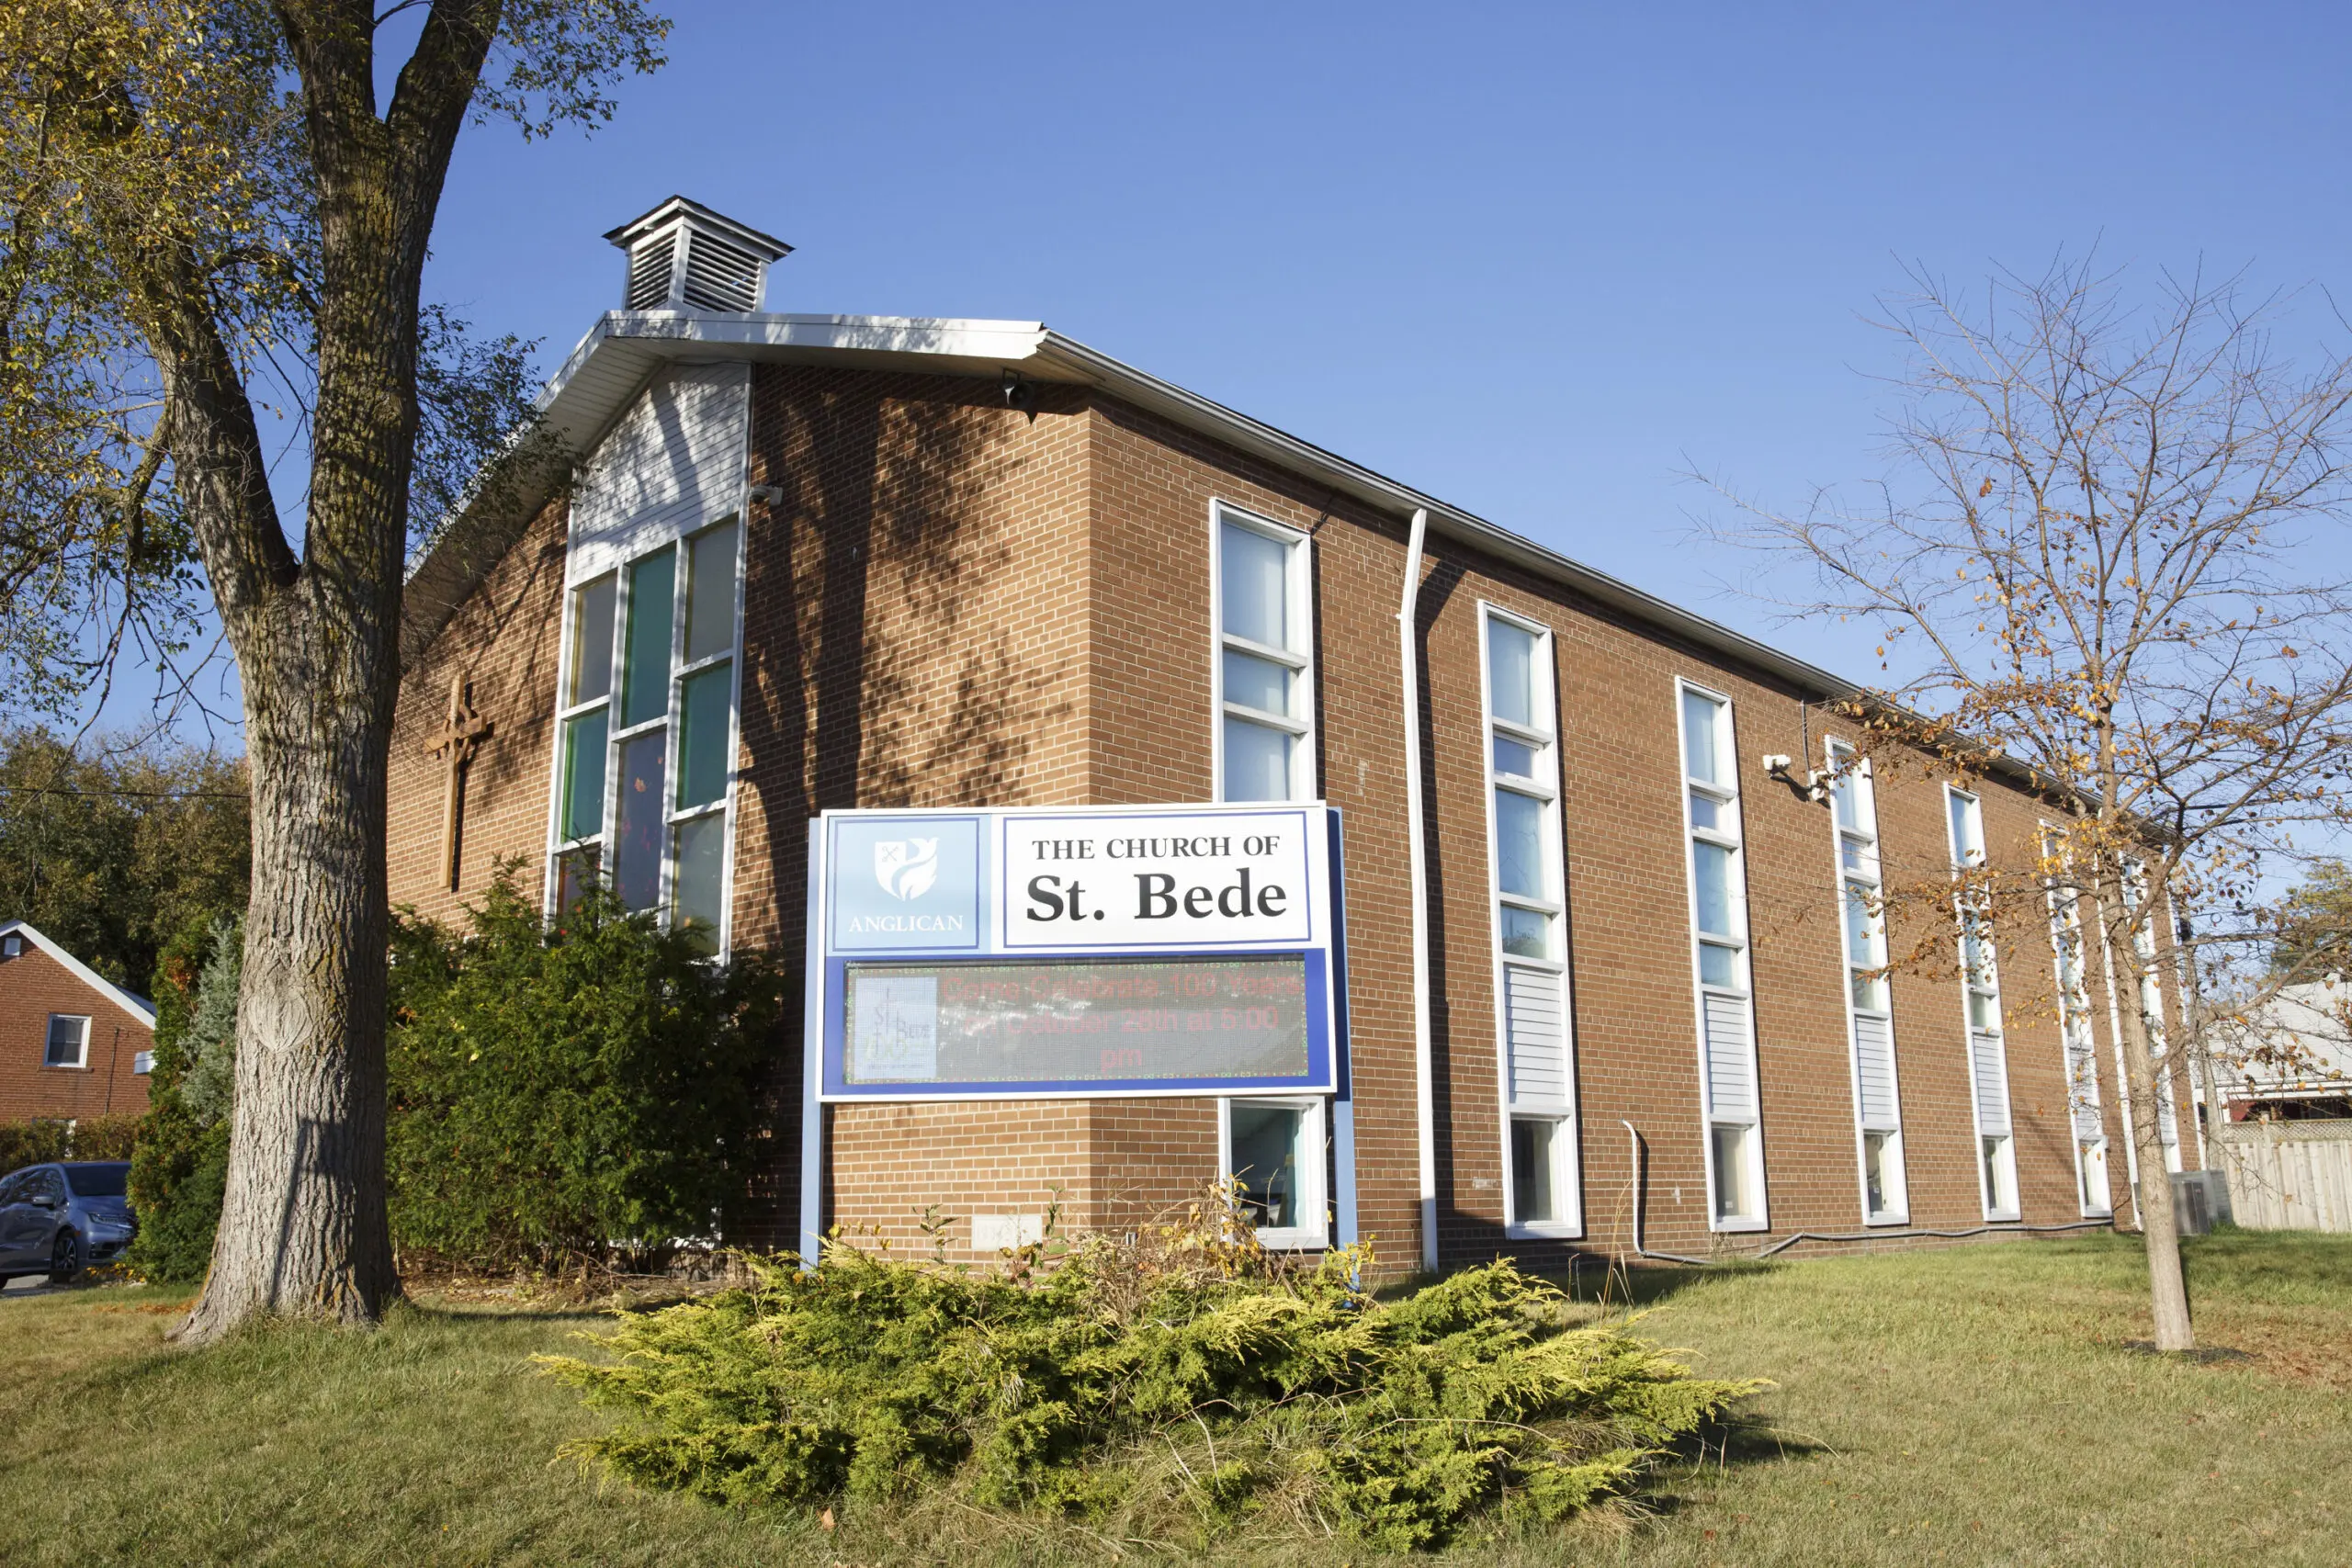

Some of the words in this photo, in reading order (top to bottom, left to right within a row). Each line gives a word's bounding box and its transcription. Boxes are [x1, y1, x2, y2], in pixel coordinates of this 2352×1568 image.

[1033, 840, 1094, 859] THE
[1107, 838, 1230, 858] CHURCH
[1244, 836, 1279, 855] OF
[1027, 875, 1104, 921] St.
[1134, 867, 1286, 919] Bede
[848, 914, 963, 933] ANGLICAN
[942, 976, 1020, 1001] Come
[1030, 974, 1159, 1000] Celebrate
[1170, 972, 1216, 998] 100
[1226, 971, 1300, 996] Years
[1007, 1008, 1114, 1034] October
[1187, 1009, 1214, 1031] at
[1221, 1005, 1279, 1030] 5:00
[1101, 1048, 1142, 1072] pm
